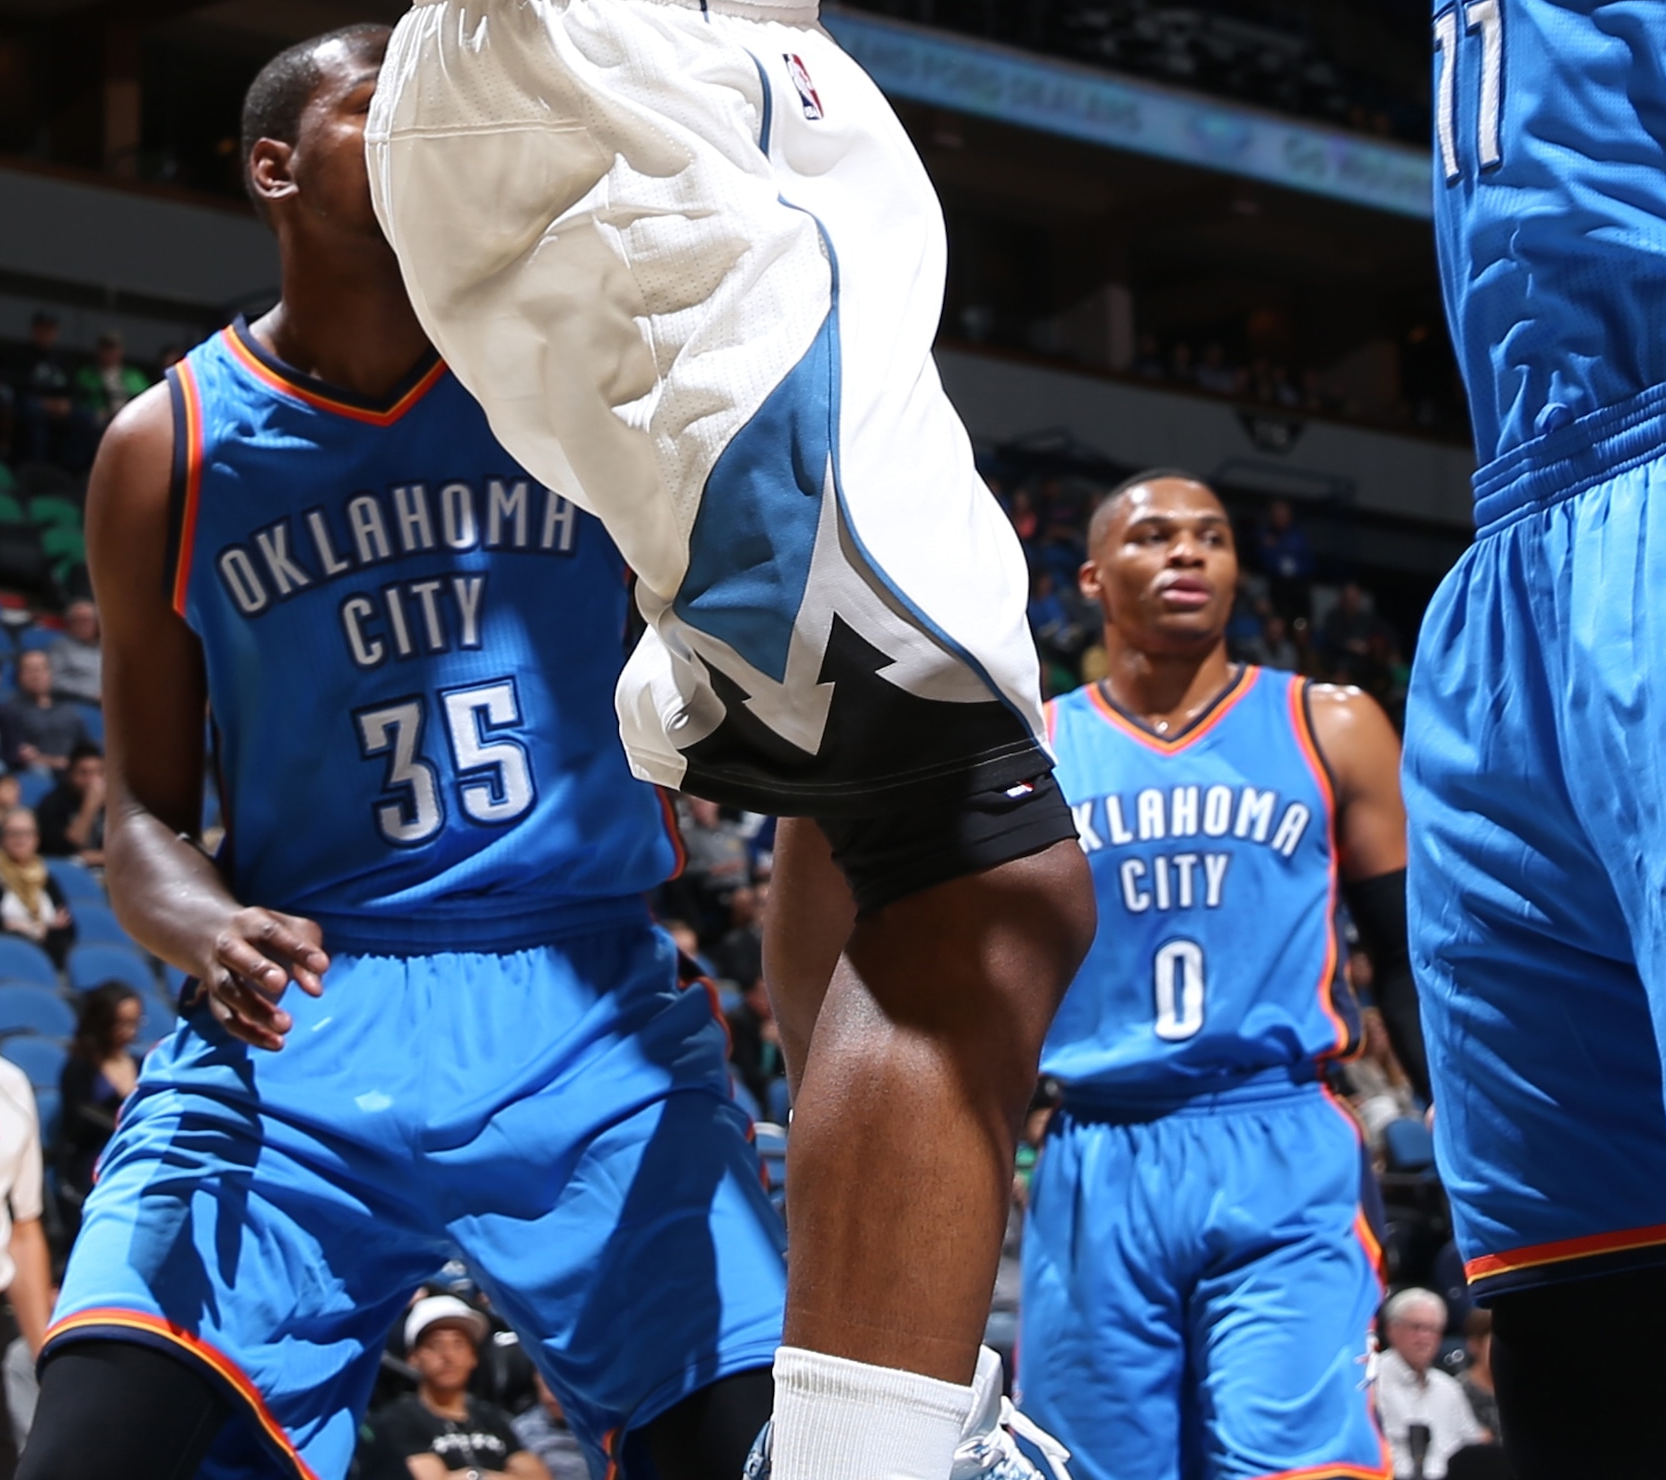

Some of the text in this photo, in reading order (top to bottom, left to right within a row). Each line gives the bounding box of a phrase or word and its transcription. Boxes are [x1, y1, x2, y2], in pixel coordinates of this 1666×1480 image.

[215, 477, 580, 618] OKLAHOMA
[340, 570, 488, 668] CITY
[352, 675, 537, 848] 35
[1071, 784, 1311, 860] KLAHOMA
[1119, 851, 1230, 912] CITY
[1153, 937, 1205, 1041] 0
